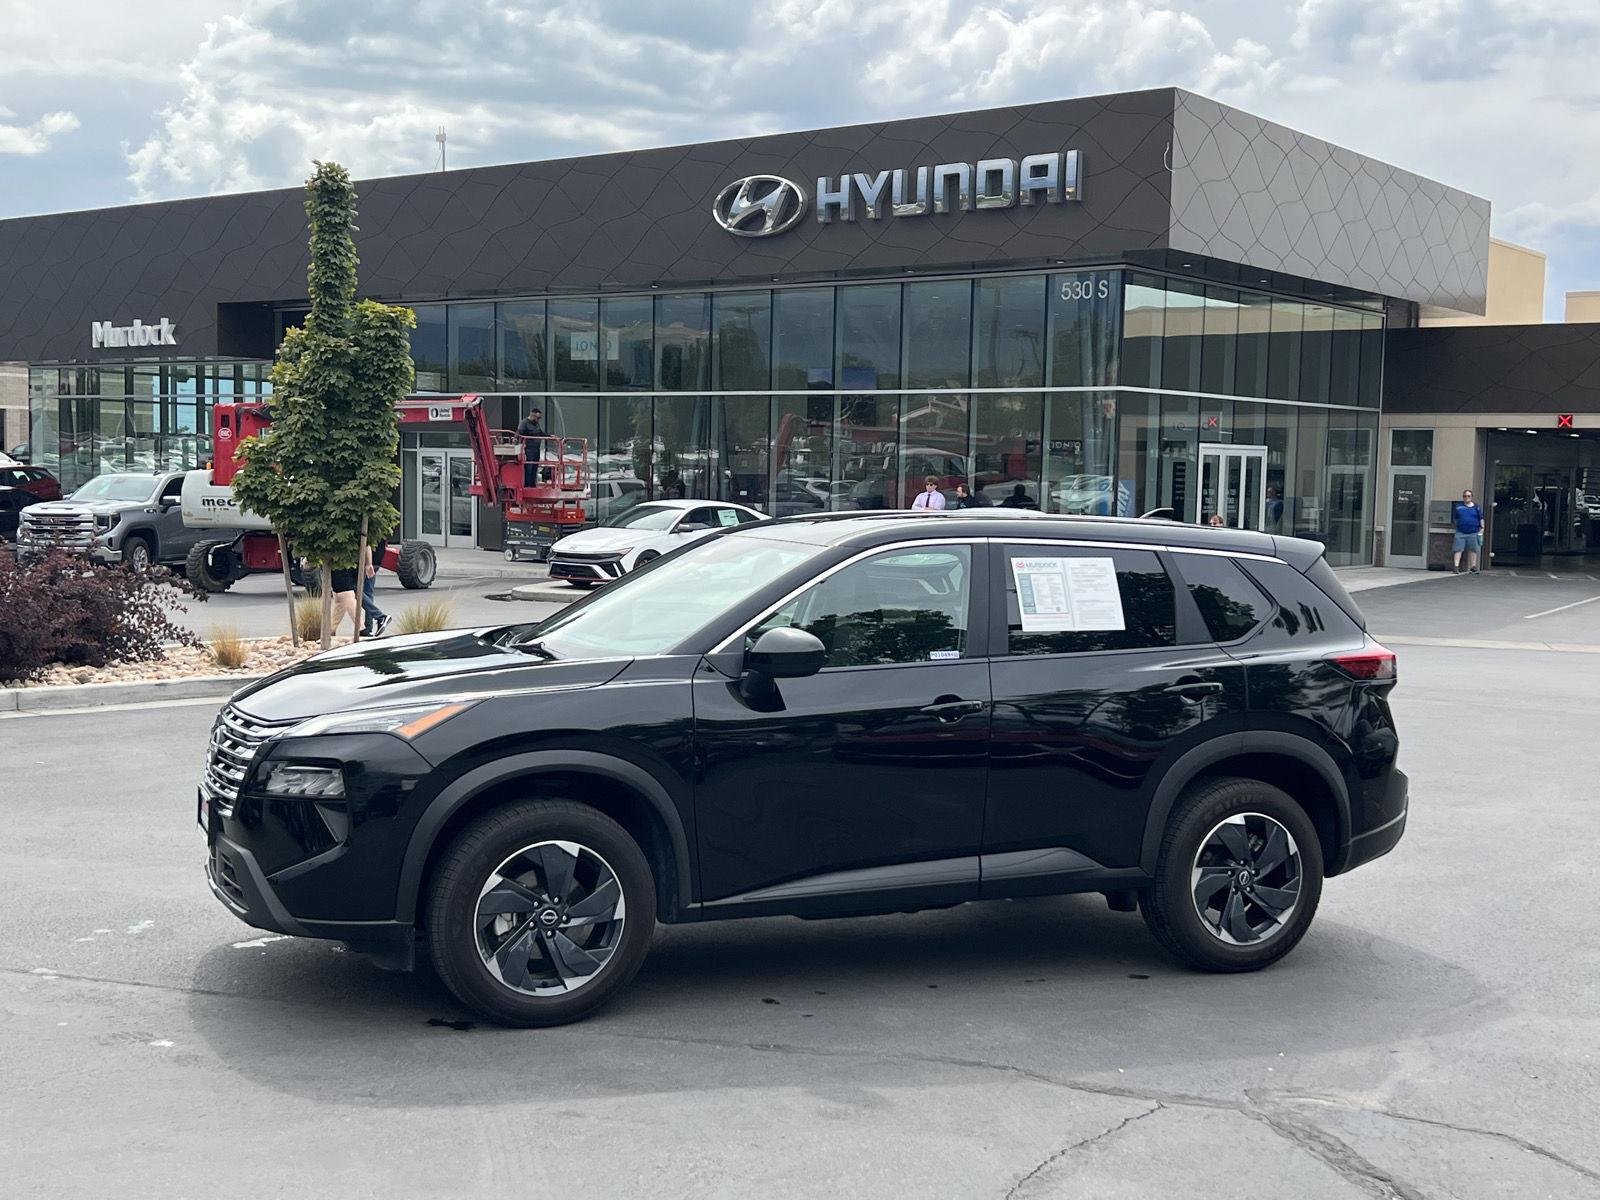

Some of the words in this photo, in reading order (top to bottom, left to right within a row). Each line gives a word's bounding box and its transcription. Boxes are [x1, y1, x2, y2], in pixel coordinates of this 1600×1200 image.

[816, 150, 1083, 223] HYUNDAI
[1061, 280, 1092, 300] 530
[1098, 279, 1108, 299] S
[91, 317, 177, 349] Murdock
